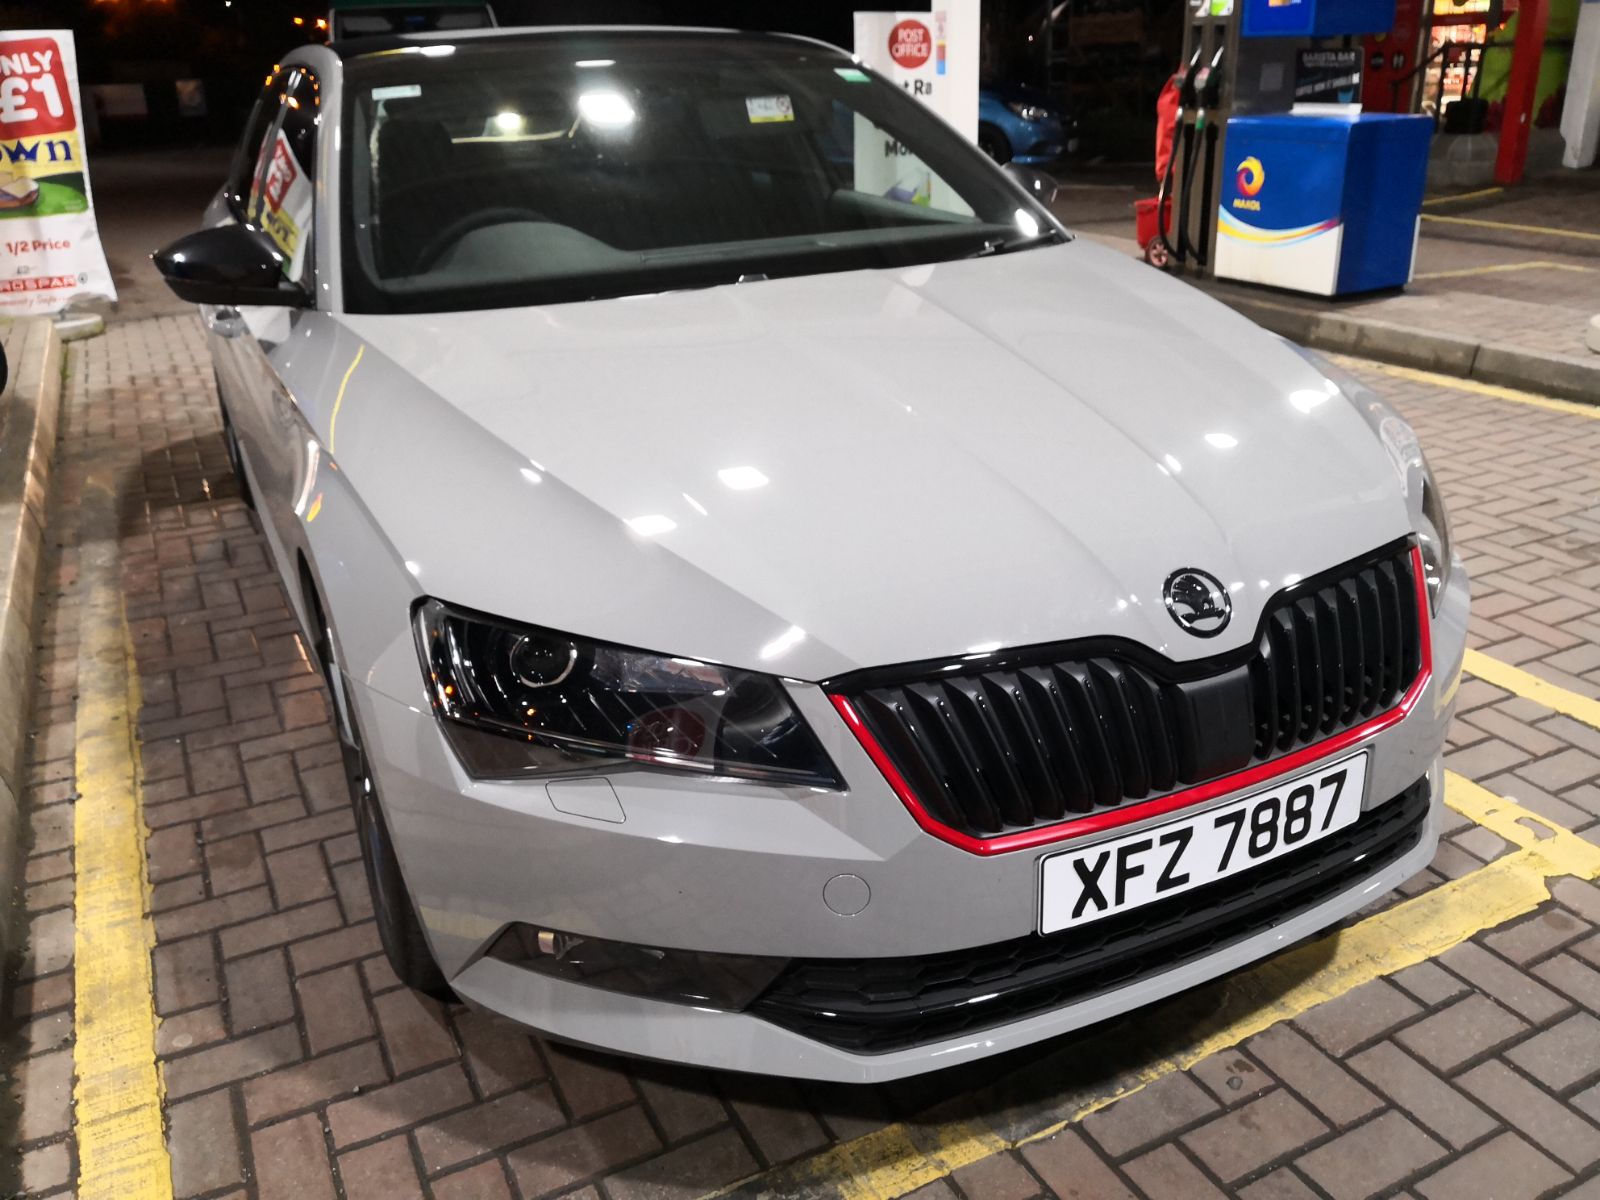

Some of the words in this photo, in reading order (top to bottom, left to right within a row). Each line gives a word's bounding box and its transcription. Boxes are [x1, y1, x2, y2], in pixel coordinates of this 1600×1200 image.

[898, 28, 924, 43] POST
[891, 42, 929, 58] OFFICE
[0, 49, 53, 77] NLY
[0, 72, 64, 124] £1
[0, 139, 73, 164] wn
[5, 240, 29, 256] 1/2
[32, 238, 71, 251] Price
[1071, 825, 1194, 919] XFZ
[1213, 768, 1347, 873] 7887
